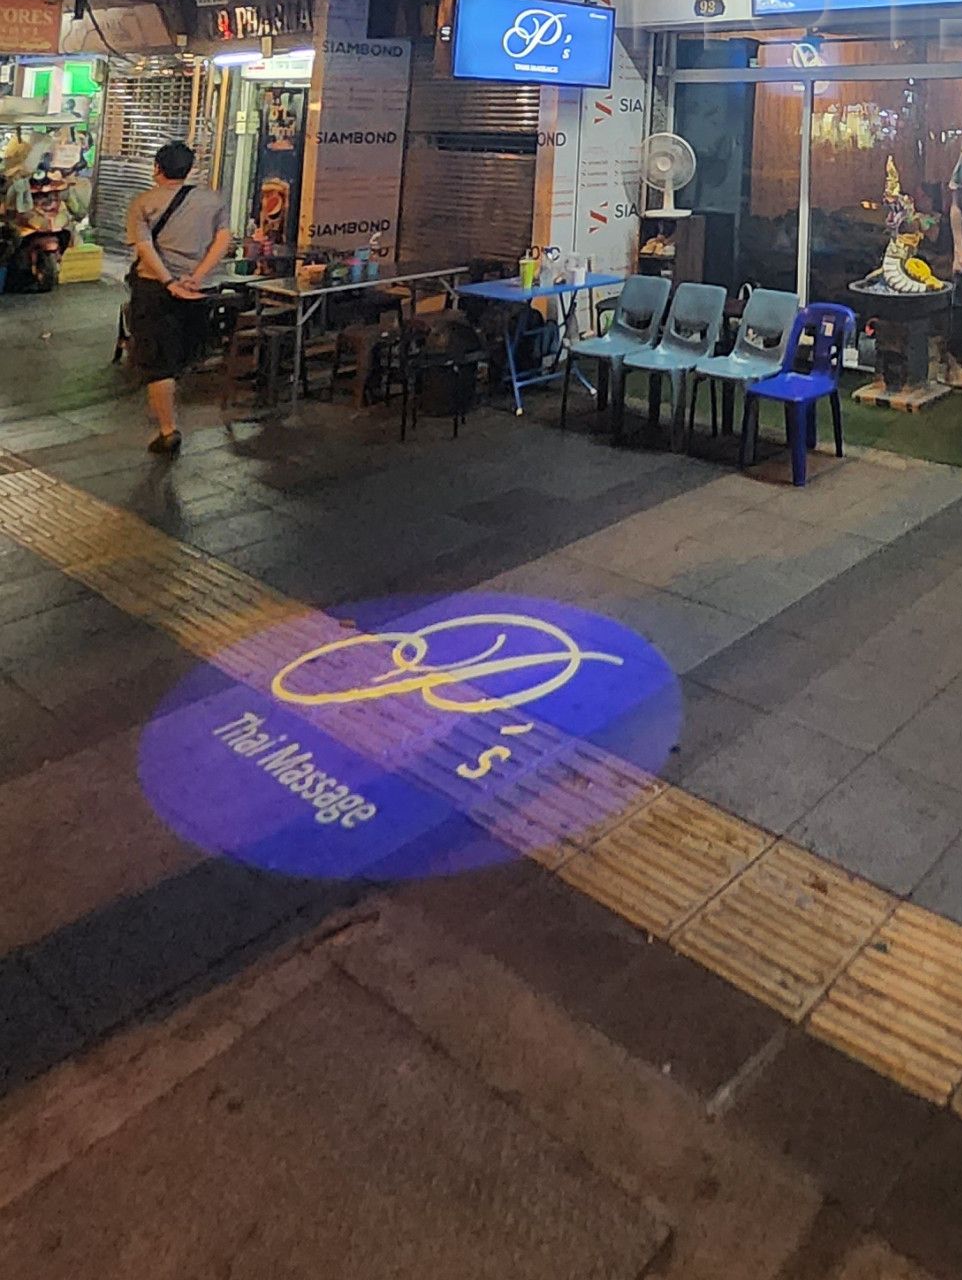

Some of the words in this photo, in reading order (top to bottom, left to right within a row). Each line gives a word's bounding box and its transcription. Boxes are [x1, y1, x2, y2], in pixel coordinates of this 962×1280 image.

[322, 40, 403, 57] SIAMBOND
[316, 131, 397, 144] SIAMBOND
[308, 219, 390, 238] SIAMBOND
[213, 712, 288, 757] Thai
[256, 742, 377, 829] Massage
